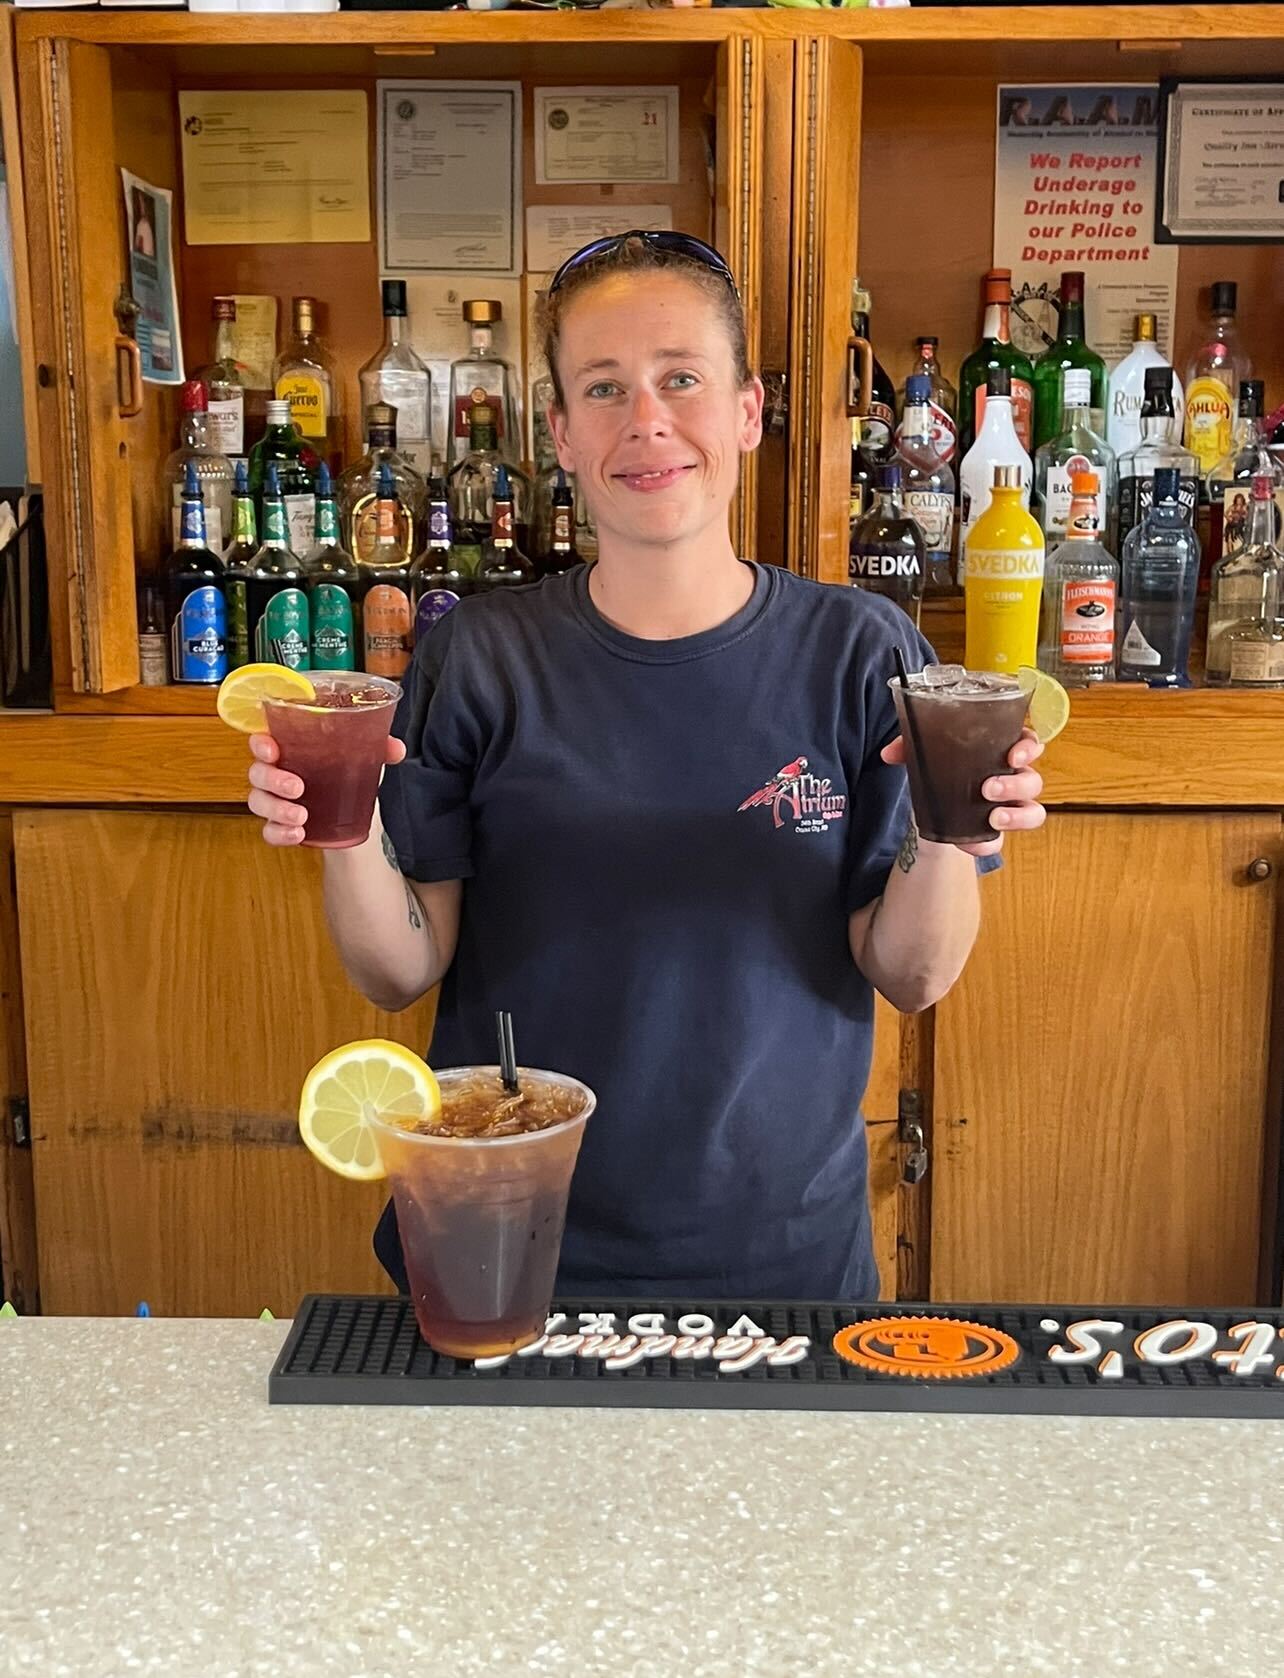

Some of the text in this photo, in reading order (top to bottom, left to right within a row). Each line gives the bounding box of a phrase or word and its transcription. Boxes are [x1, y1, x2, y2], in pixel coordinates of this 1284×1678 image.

[1029, 153, 1142, 171] We Report
[1034, 176, 1136, 195] Underage
[1024, 200, 1143, 218] Drinking to
[1029, 222, 1137, 239] our Police
[1021, 246, 1150, 264] Department
[849, 554, 920, 576] SVEDKA
[968, 554, 1039, 574] SVEDKA
[1068, 632, 1109, 643] ORANGE
[800, 773, 832, 795] The
